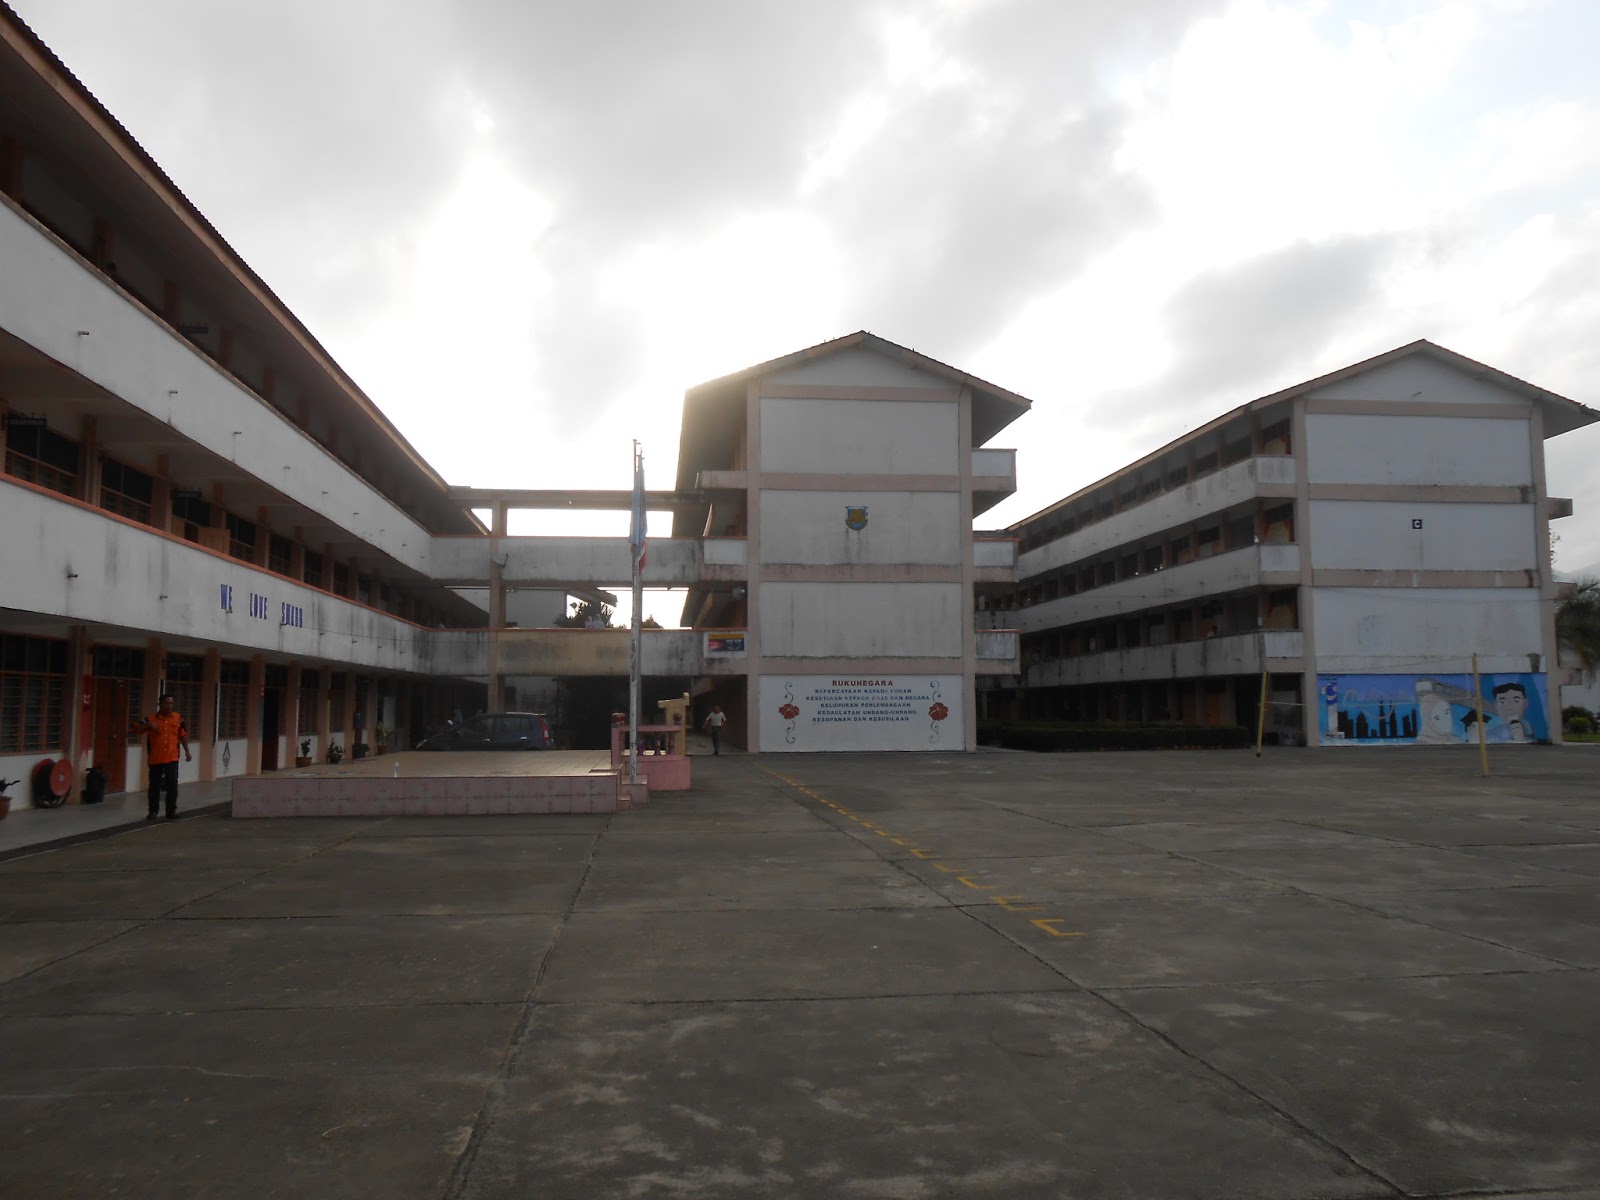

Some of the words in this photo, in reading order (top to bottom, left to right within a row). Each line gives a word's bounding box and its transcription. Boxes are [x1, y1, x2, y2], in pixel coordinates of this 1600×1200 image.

[1413, 520, 1421, 528] C
[221, 584, 232, 610] WE
[250, 592, 267, 620] LOVE
